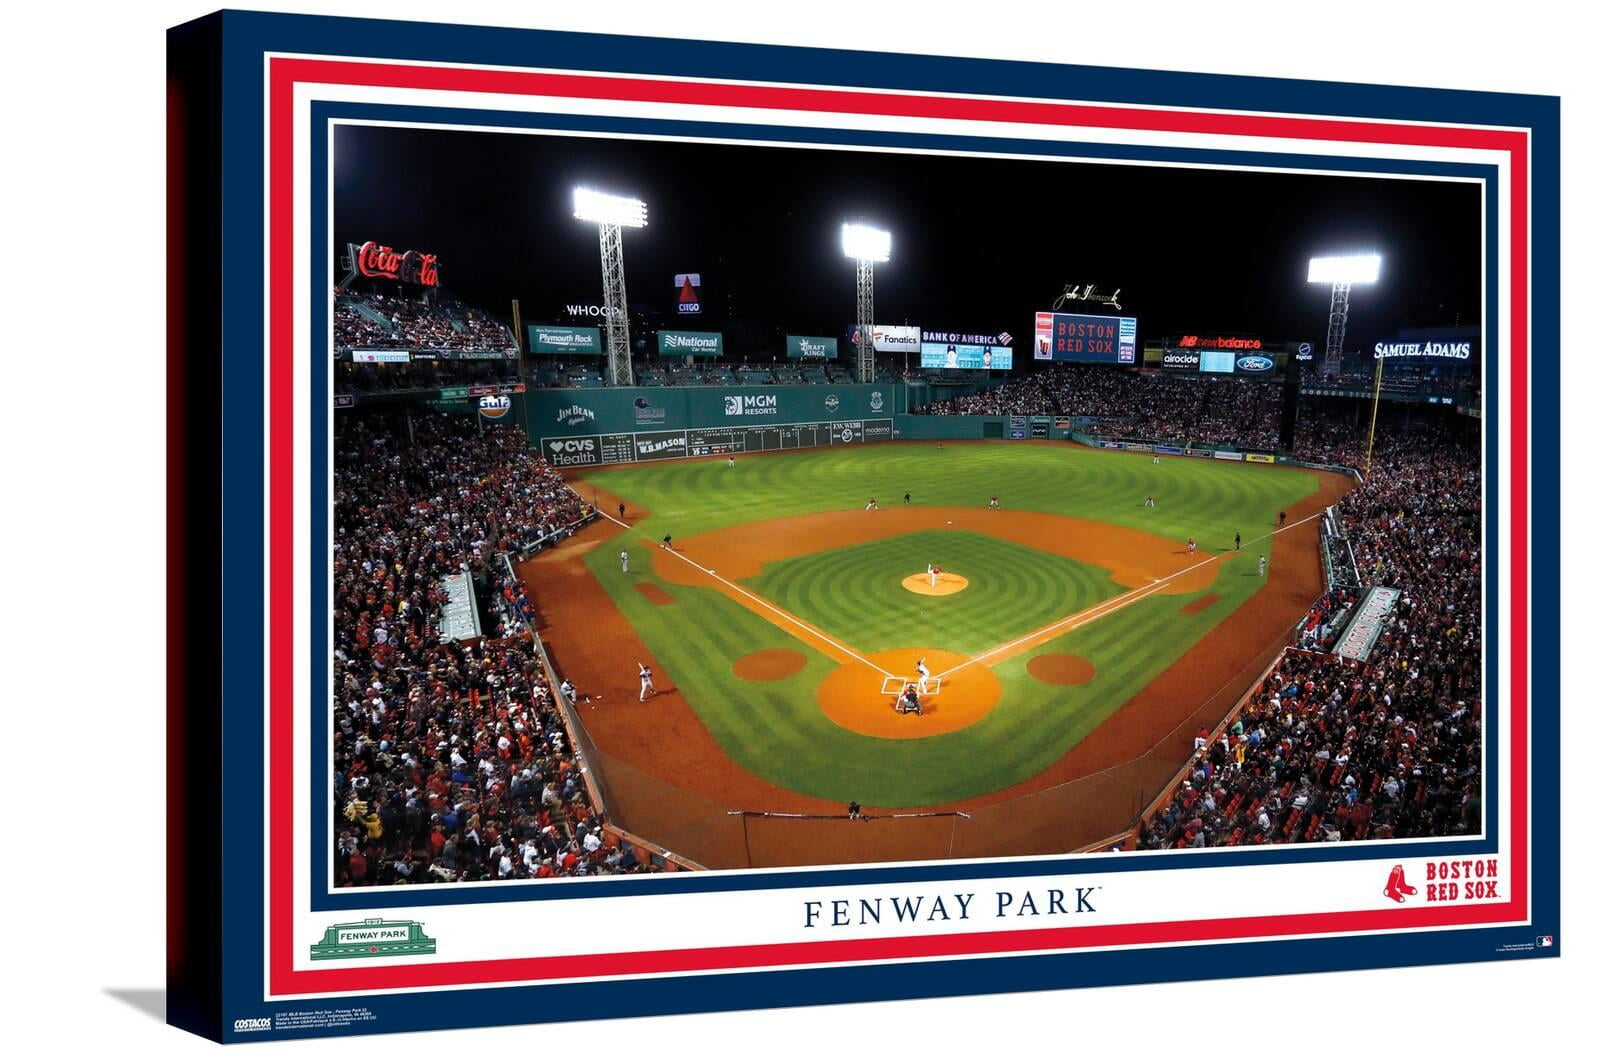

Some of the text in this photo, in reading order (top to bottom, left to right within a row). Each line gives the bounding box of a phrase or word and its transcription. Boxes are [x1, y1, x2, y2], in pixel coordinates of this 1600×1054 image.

[566, 304, 620, 318] WHOOP
[679, 303, 700, 312] CITGO
[1058, 322, 1114, 338] BOSTON
[539, 333, 593, 344] Plymouth Rock
[677, 336, 718, 347] National
[884, 334, 917, 344] Fanatics
[923, 331, 998, 345] BANK OF AMERICA
[1057, 338, 1113, 353] RED SOX
[1374, 341, 1471, 360] SAMUEL ADAMS
[1164, 354, 1199, 364] airocide
[1243, 359, 1266, 369] Ford
[480, 396, 510, 408] Gulf
[744, 396, 777, 407] MGM
[557, 408, 572, 422] JIM
[572, 405, 595, 420] BEAM
[744, 407, 777, 415] RESORTS
[564, 439, 595, 453] CVS
[552, 452, 596, 466] Health
[1426, 859, 1498, 881] BOSTON
[1426, 880, 1499, 902] RED SOX
[804, 887, 1097, 928] FENWAY PARK
[340, 930, 407, 941] FENWAY PARK
[233, 1017, 272, 1029] COSTACOS
